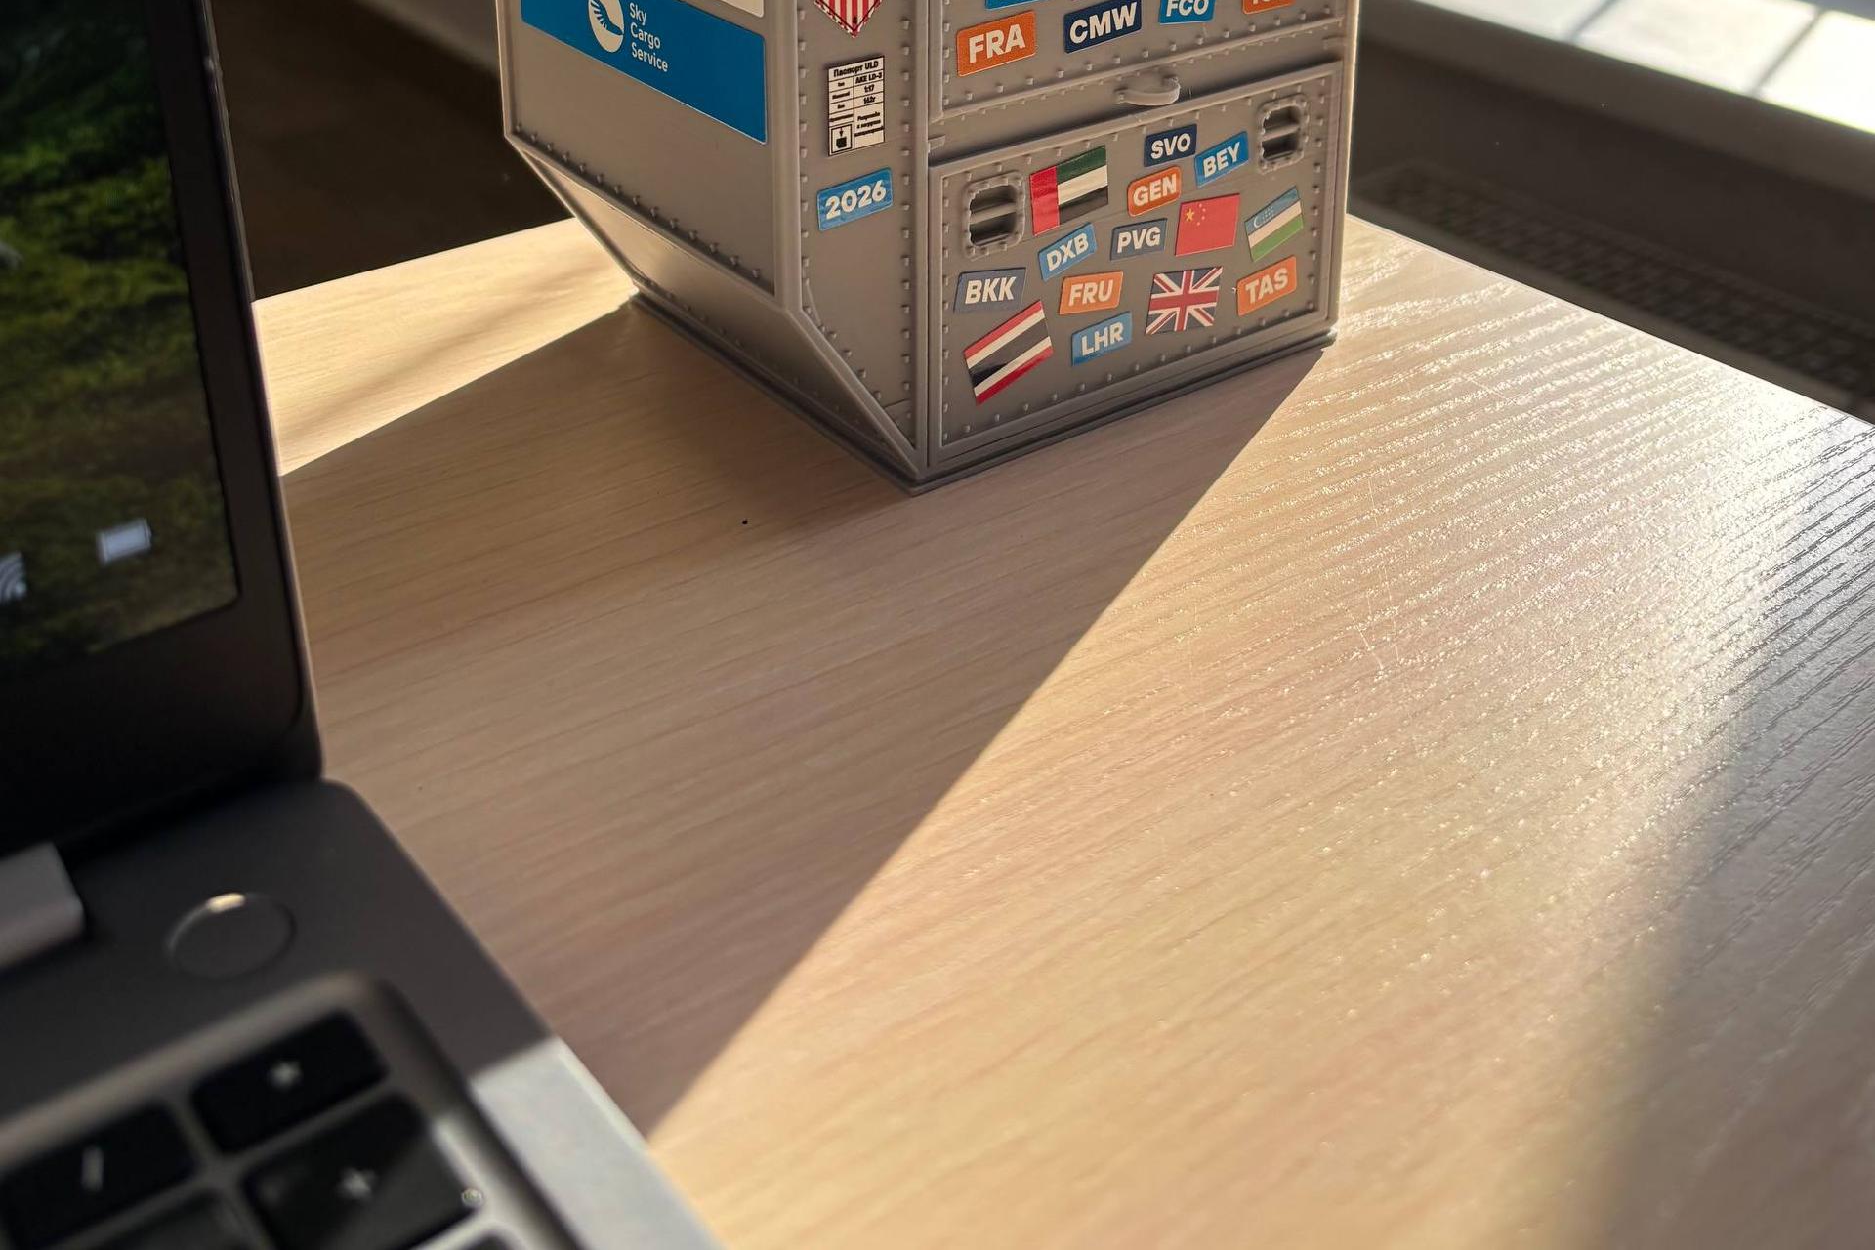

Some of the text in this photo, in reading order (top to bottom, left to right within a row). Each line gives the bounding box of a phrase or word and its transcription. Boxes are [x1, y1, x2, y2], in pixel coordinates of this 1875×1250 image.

[629, 2, 648, 26] Sky
[1068, 2, 1137, 45] CMW
[629, 22, 661, 52] Cargo
[968, 23, 1026, 64] FRA
[631, 42, 669, 73] Service
[1150, 133, 1191, 159] SVO
[1202, 143, 1241, 178] BEY
[825, 180, 887, 220] 2026
[1133, 174, 1178, 208] GEN
[1046, 232, 1089, 272] DXB
[1116, 227, 1161, 254] PVG
[964, 277, 1015, 305] BKK
[1068, 279, 1114, 307] FRU
[1244, 268, 1289, 305] TAS
[1080, 321, 1125, 356] LHR
